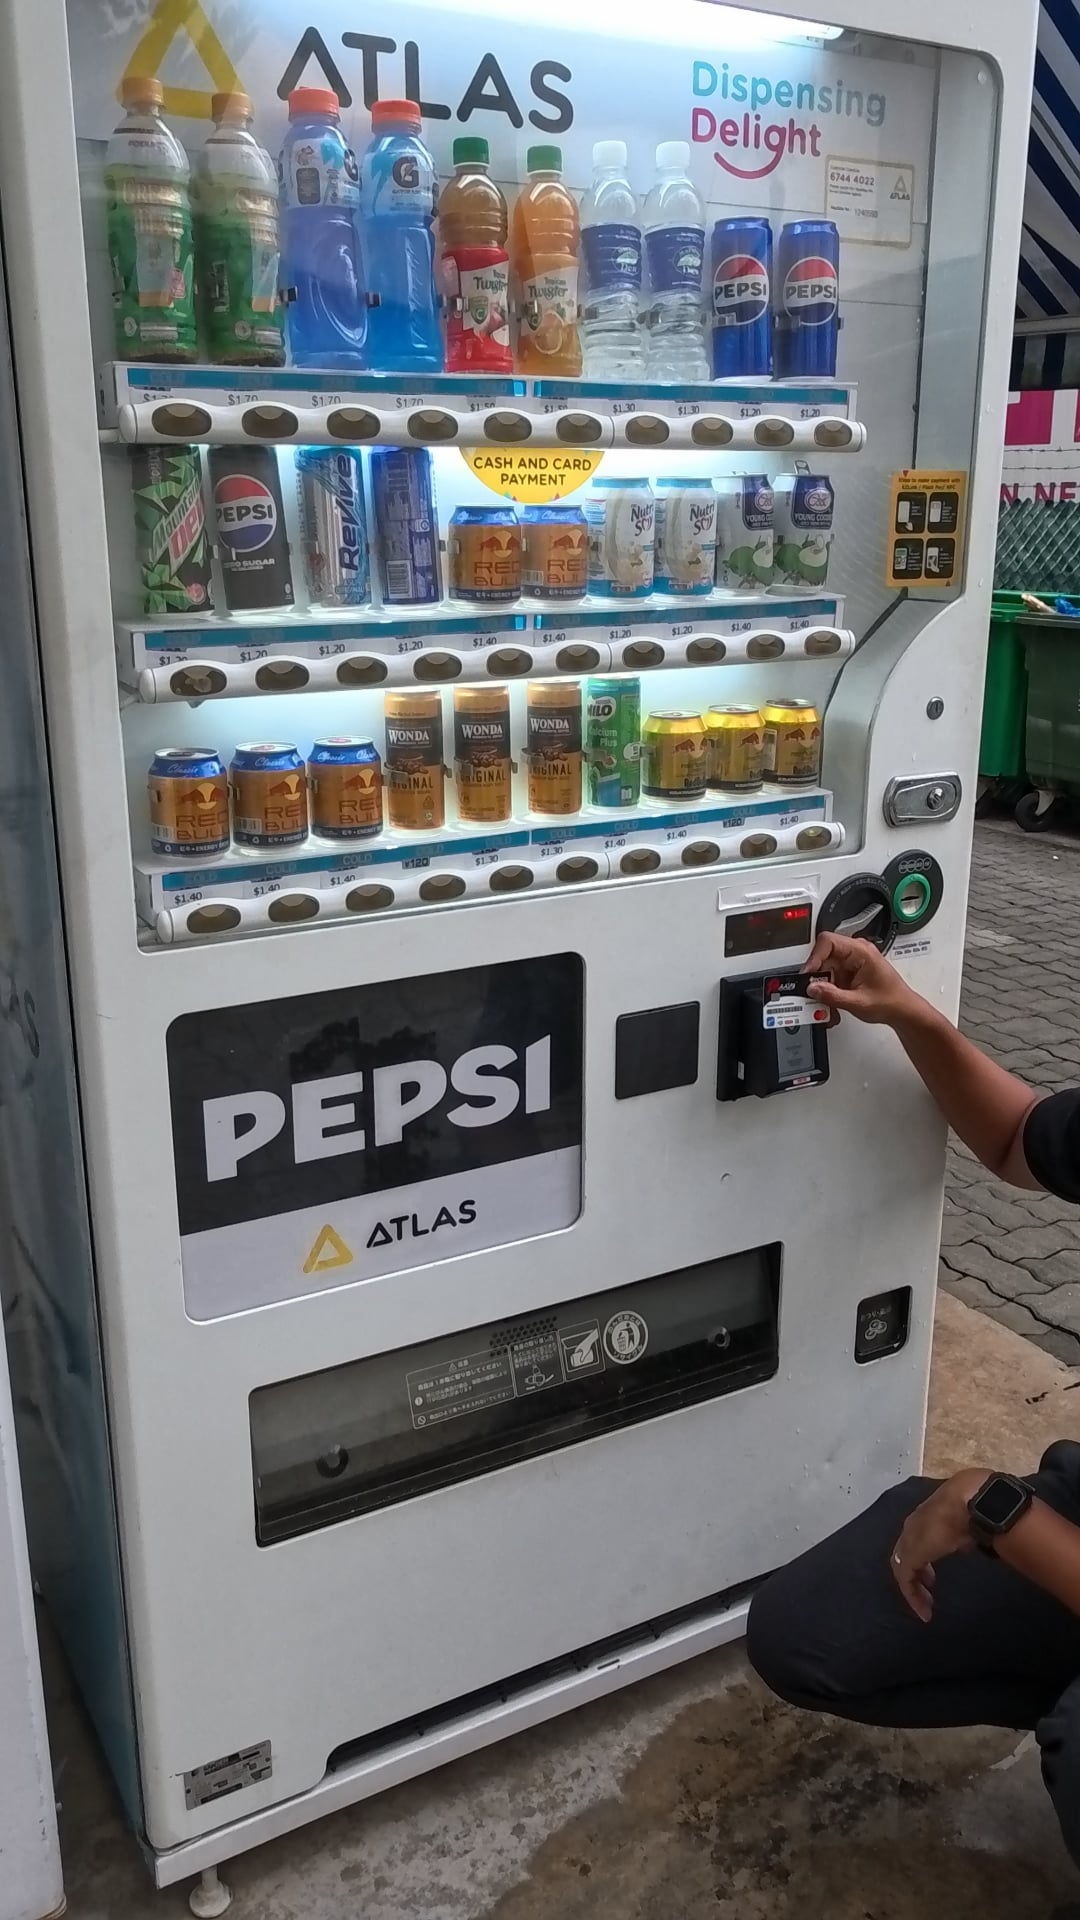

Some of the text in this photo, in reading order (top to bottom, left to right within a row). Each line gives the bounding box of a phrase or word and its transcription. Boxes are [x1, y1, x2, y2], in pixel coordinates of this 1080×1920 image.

[277, 26, 574, 133] ATLAS
[692, 60, 886, 126] Dispensing
[692, 107, 821, 179] Delight
[830, 173, 875, 186] 6744 4022
[714, 282, 767, 300] PEPSI
[785, 282, 837, 299] PEPSI
[612, 403, 636, 414] $1.30
[678, 405, 700, 415] $1.30
[740, 407, 761, 417] $1.20
[800, 407, 821, 417] $1.20
[473, 456, 592, 472] CASH AND CARD
[500, 472, 566, 487] PAYMENT
[215, 503, 274, 522] PEPSI
[671, 625, 693, 636] $1.20
[730, 621, 752, 632] $1.40
[542, 632, 567, 644] $1.40
[608, 629, 632, 640] $1.20
[318, 643, 346, 656] $1.20
[397, 640, 424, 653] $1.20
[472, 637, 498, 649] $1.40
[240, 650, 268, 662] $1.20
[461, 723, 503, 739] WONDA
[530, 717, 570, 733] WONDA
[388, 729, 429, 744] WONDA
[779, 814, 800, 826] $1.40
[666, 829, 688, 840] $1.40
[604, 838, 626, 849] $1.40
[540, 846, 563, 857] $1.30
[475, 855, 499, 866] $1.30
[330, 874, 356, 886] $1.40
[253, 883, 281, 896] $1.40
[174, 891, 203, 905] $1.40
[203, 1034, 551, 1183] PEPSI
[366, 1200, 477, 1249] ATLAS
